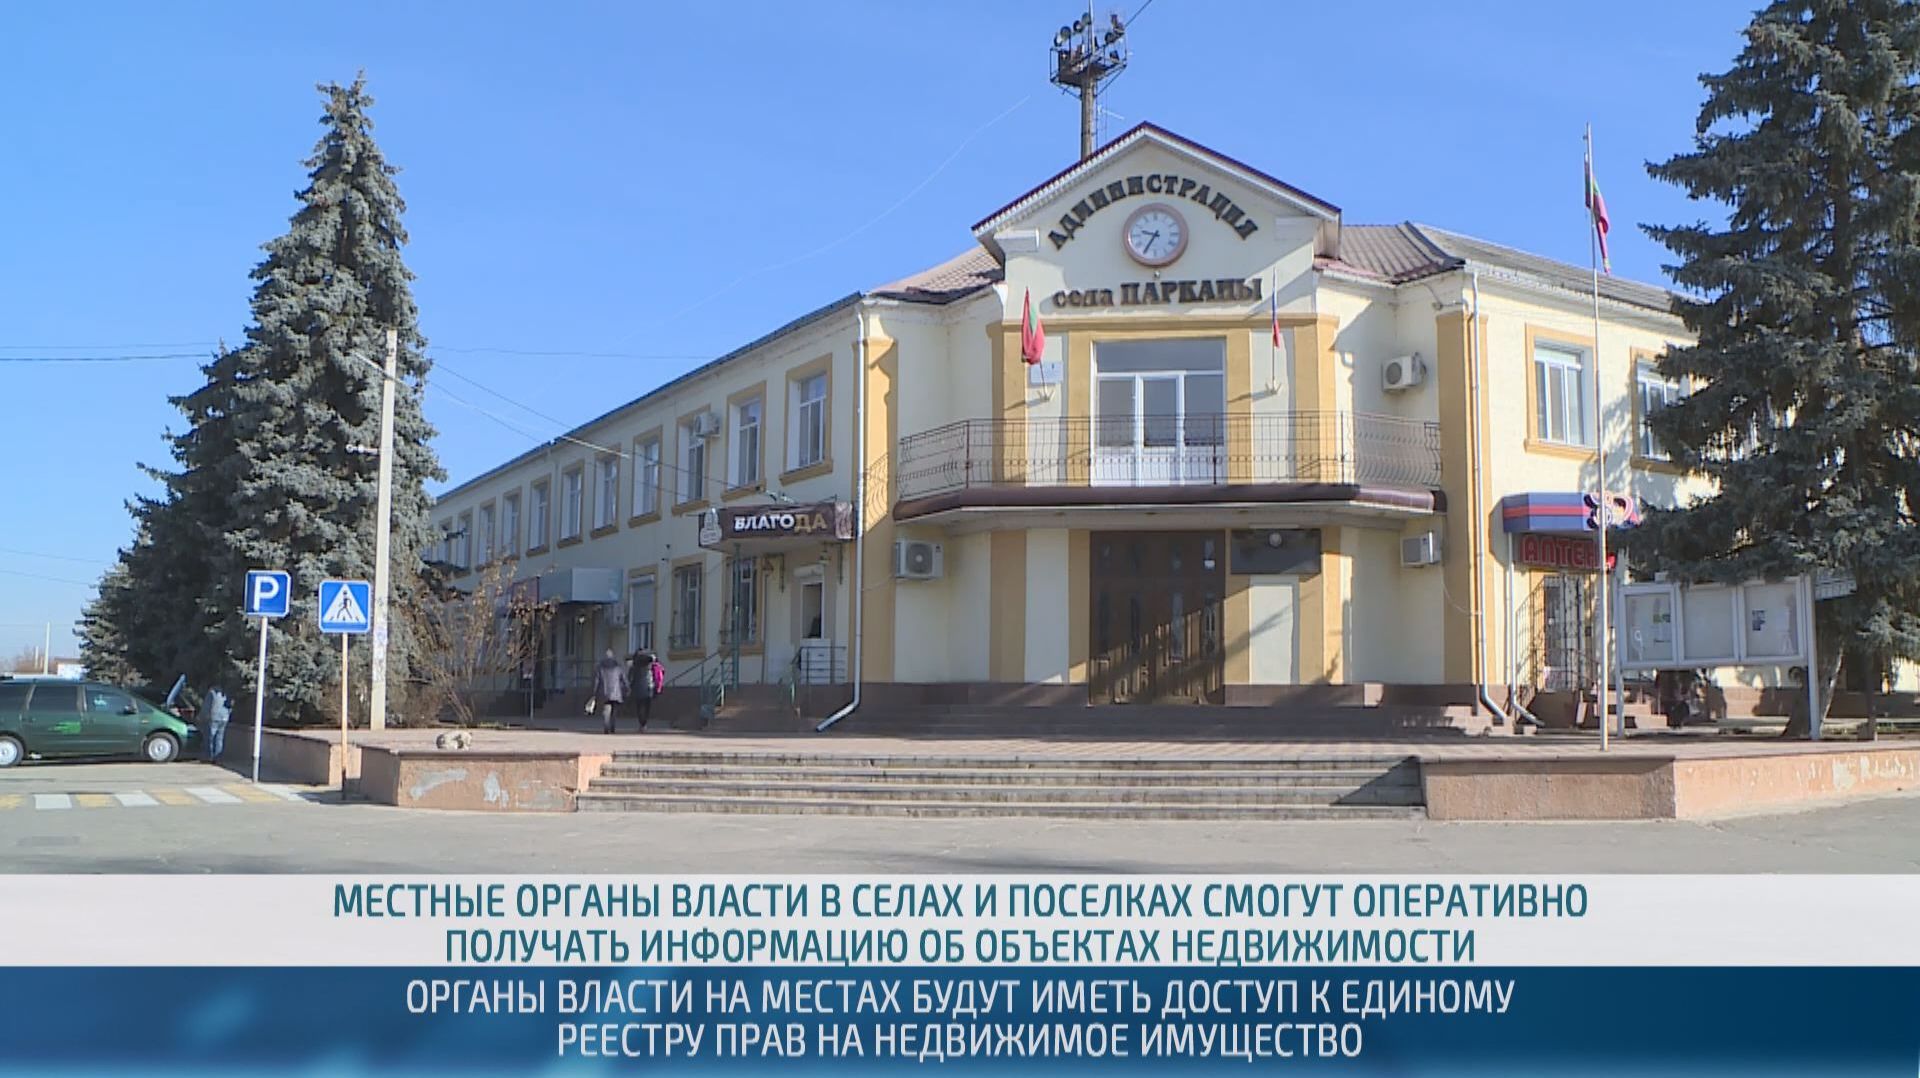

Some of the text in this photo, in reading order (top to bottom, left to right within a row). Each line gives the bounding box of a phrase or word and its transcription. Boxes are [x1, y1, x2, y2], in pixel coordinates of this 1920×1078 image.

[1048, 173, 1260, 251] АДМИНИСТРАЦИЯ
[1053, 277, 1264, 308] села ПАРКАНЫ
[734, 512, 828, 533] БЛАГОДА
[252, 575, 280, 612] P
